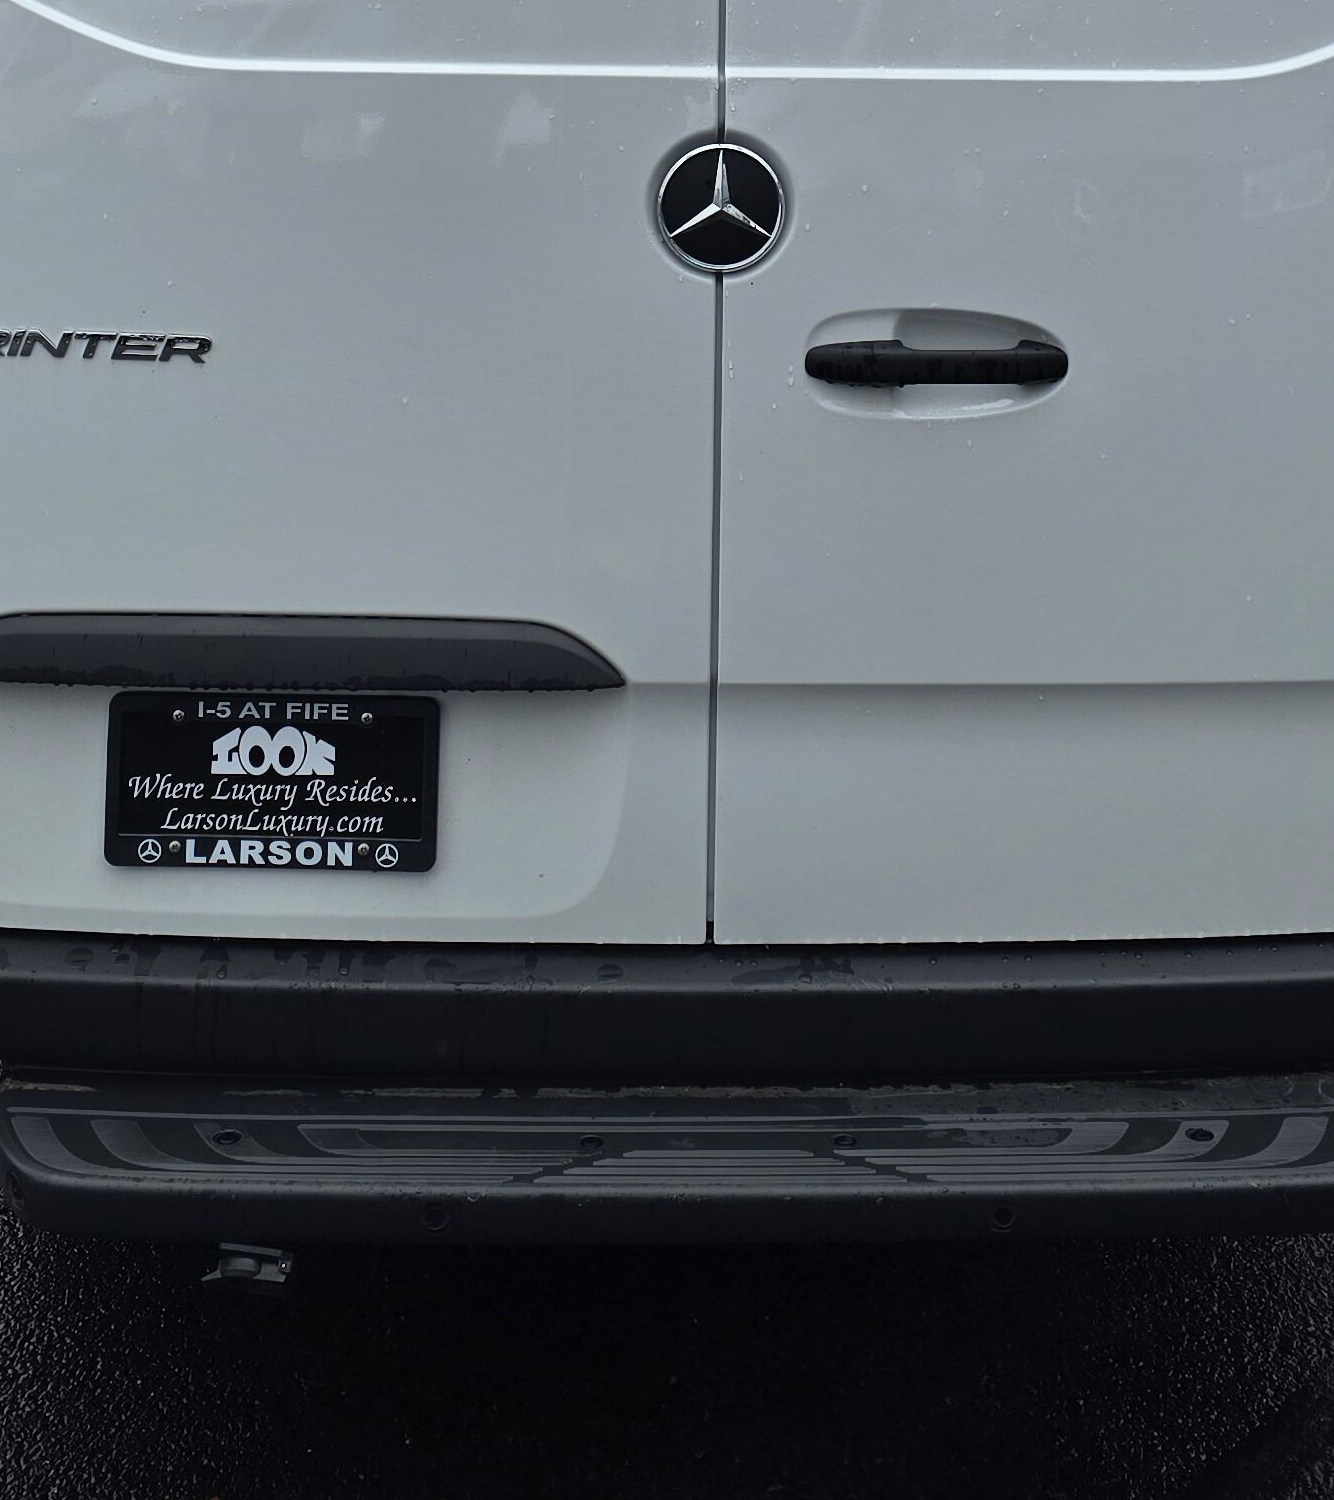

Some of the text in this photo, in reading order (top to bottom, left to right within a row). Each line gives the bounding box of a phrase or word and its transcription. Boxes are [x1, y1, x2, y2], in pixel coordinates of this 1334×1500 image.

[197, 701, 350, 721] I-5 AT FIFE
[210, 725, 336, 776] LOOK
[128, 773, 417, 811] Where Luxury Resides...
[159, 807, 385, 838] LarsonLuxury.com
[184, 838, 354, 867] LARSON
